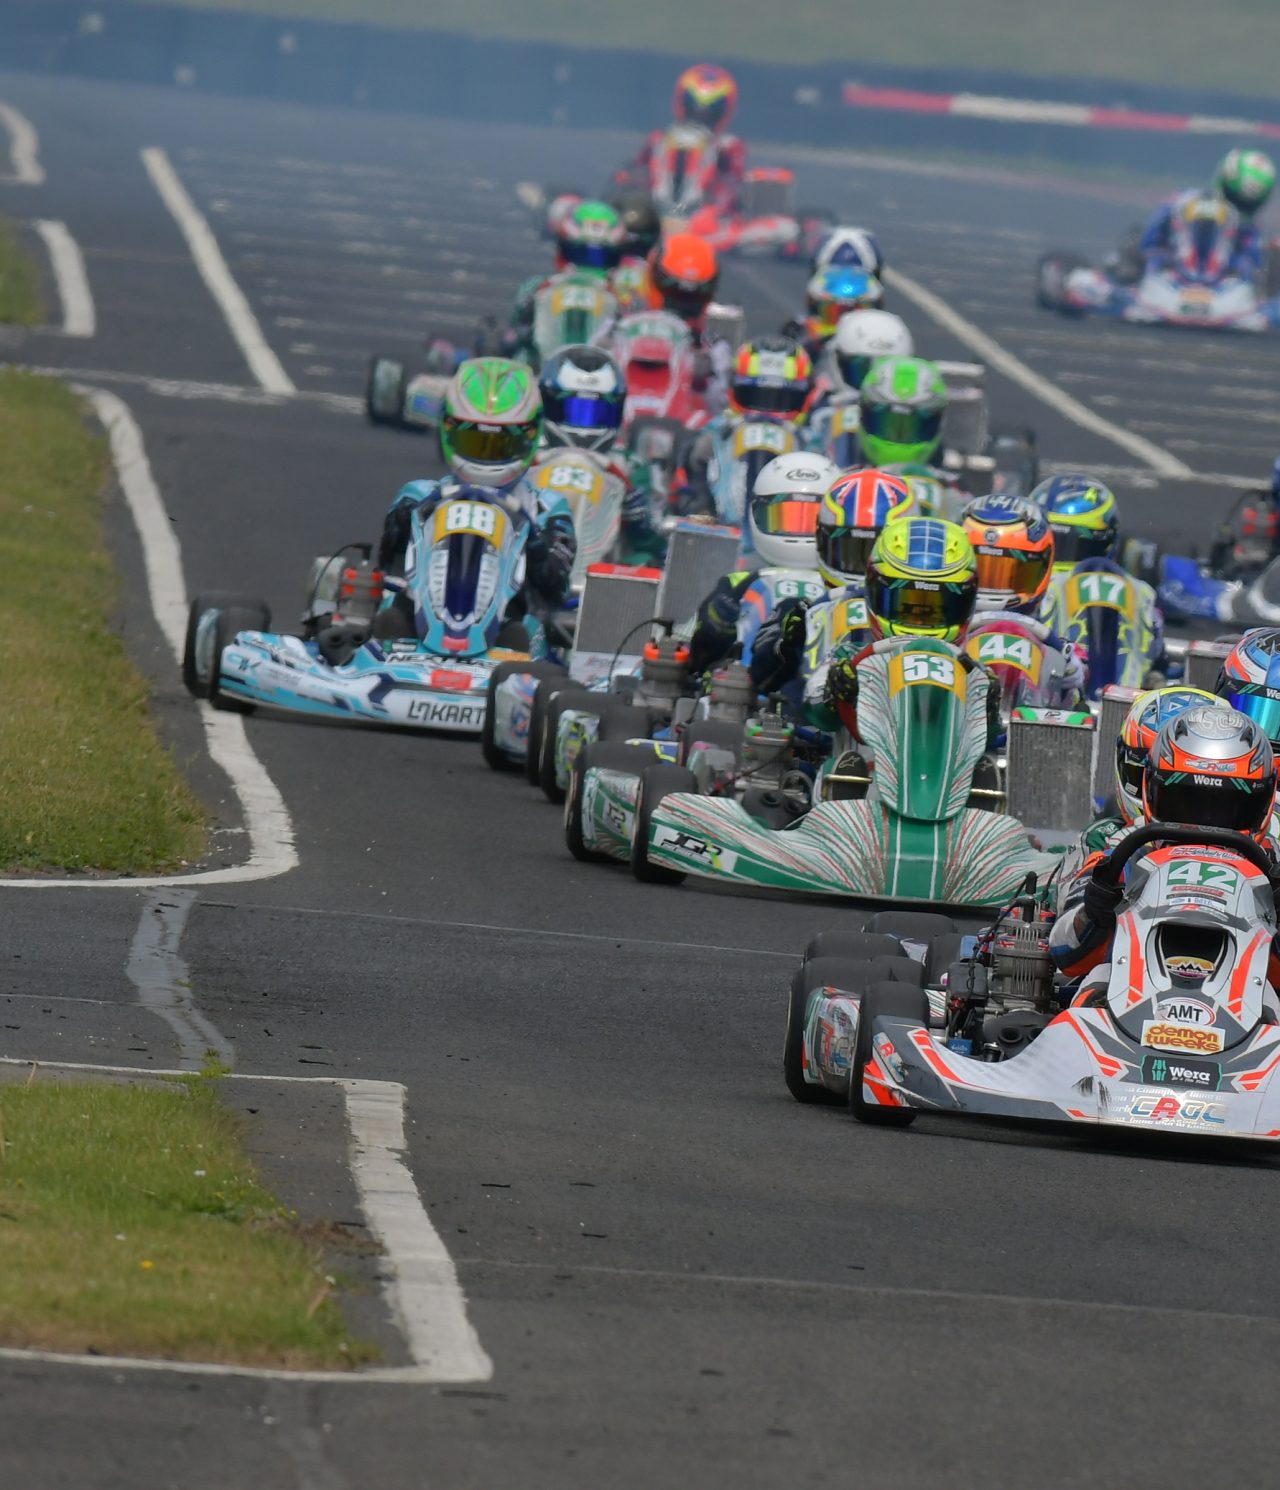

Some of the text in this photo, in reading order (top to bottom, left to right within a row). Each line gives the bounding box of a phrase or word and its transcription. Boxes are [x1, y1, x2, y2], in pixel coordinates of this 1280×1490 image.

[447, 503, 497, 535] 88
[779, 580, 825, 598] 69
[915, 581, 940, 591] Wera
[1080, 575, 1126, 602] 17
[979, 635, 1032, 667] 44
[903, 653, 954, 683] 53
[1193, 774, 1223, 787] Wera
[1168, 861, 1237, 894] 42
[1167, 1005, 1203, 1022] AMT
[1149, 1024, 1218, 1043] demon
[1146, 1034, 1220, 1052] tweeks
[1169, 1066, 1211, 1081] Wera
